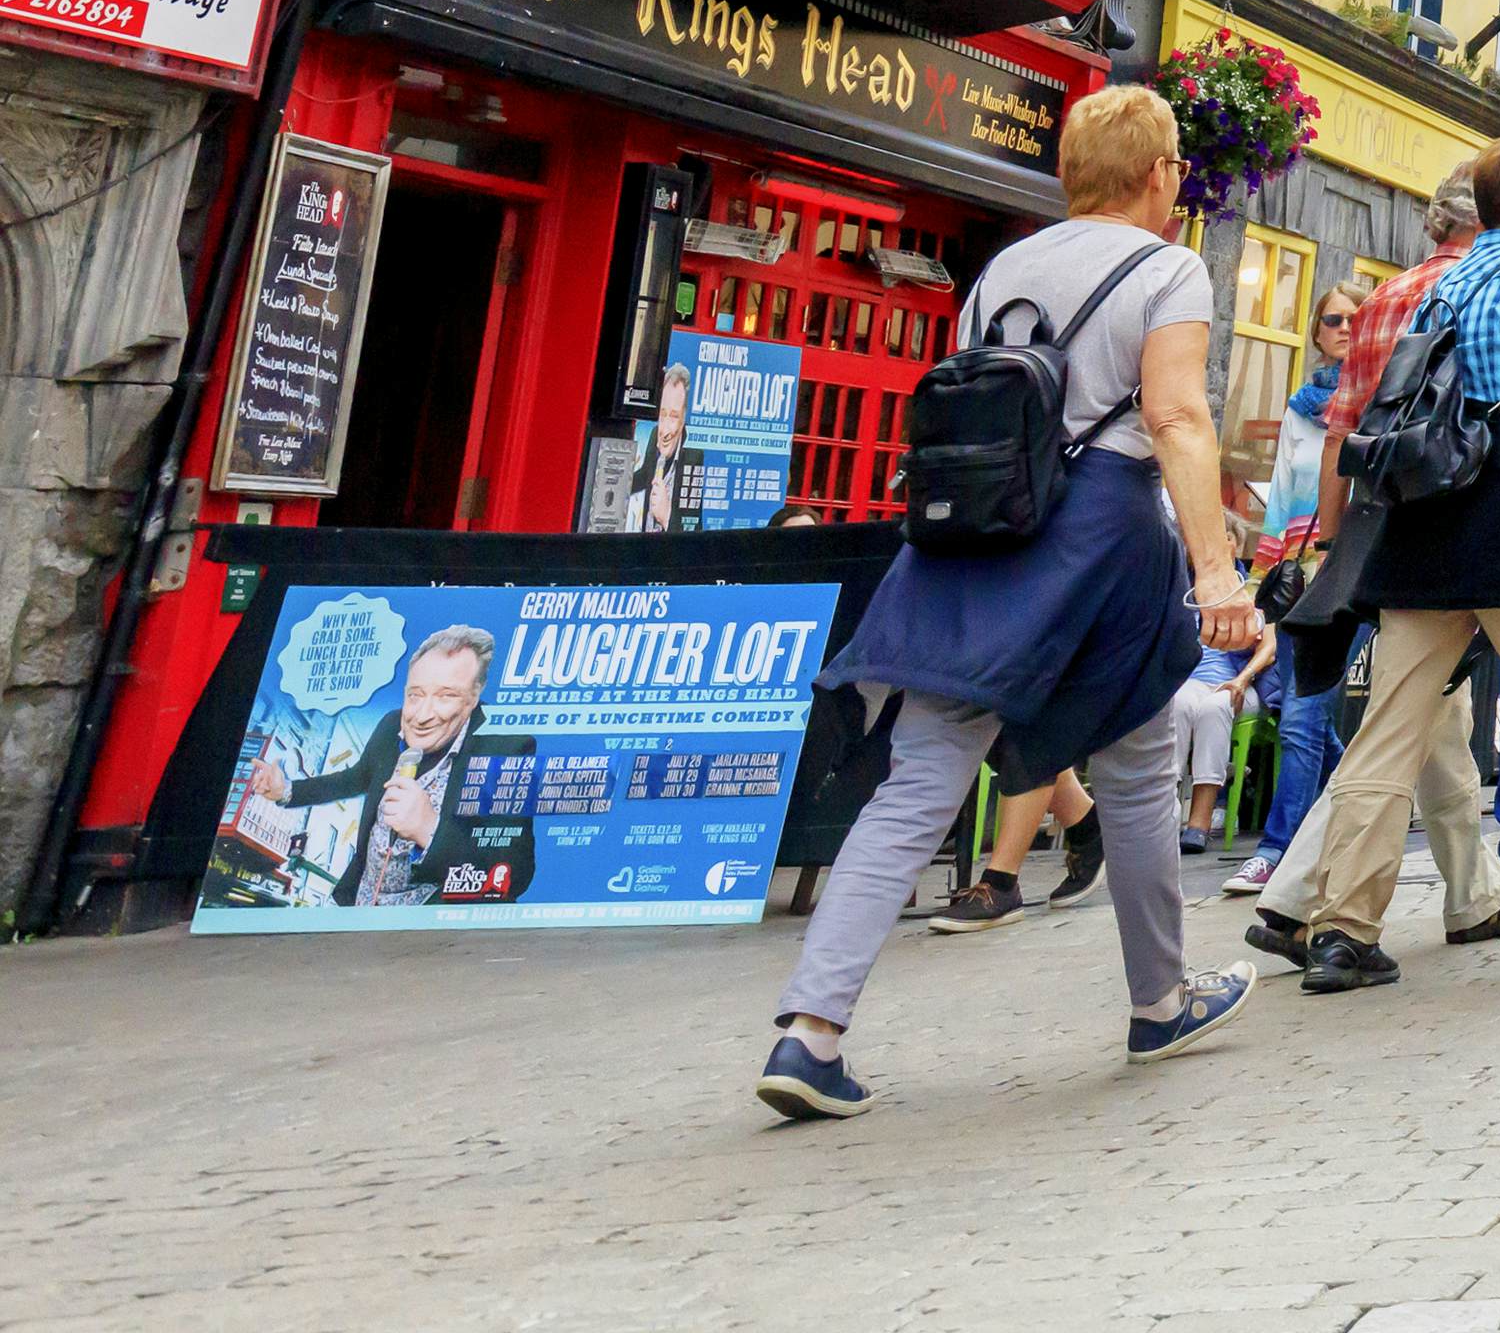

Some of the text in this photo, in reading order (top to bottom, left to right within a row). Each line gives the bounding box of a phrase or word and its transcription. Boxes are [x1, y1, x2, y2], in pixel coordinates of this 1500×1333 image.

[801, 3, 917, 113] Head
[1038, 104, 1054, 130] Bar
[971, 114, 989, 140] Bar
[296, 205, 324, 223] HEAD
[692, 366, 795, 422] LAUGHTER LOFT
[521, 592, 670, 619] GERRY MALLON'S
[322, 612, 373, 629] WHY NOT
[312, 627, 376, 645] GRAB SOME
[300, 642, 381, 661] LUNCH BEFORE
[500, 621, 817, 688] LAUGHTER LOFT
[311, 659, 363, 676] OR AFTER
[306, 675, 363, 693] THE SHOW
[496, 687, 798, 703] UPSTAIRS AT THE KINGS HEAD
[489, 710, 795, 726] HOME OF LUNCHTIME COMEDY
[604, 737, 674, 751] WEEK 2
[468, 756, 610, 770] MON JULY 24 NEIL DELAMERE
[667, 753, 779, 769] JULY JARLATH REGAN
[497, 771, 518, 784] JULY
[519, 771, 532, 784] 25
[542, 771, 573, 784] ALISON
[574, 770, 608, 783] SPITTLE
[632, 767, 778, 784] SAT JULY 29 DAVID MCSAVAGE
[461, 785, 605, 800] WED JULY JOHN COLLEARY
[628, 784, 647, 798] SUN
[660, 784, 682, 798] JULY
[682, 784, 696, 797] 30
[489, 801, 511, 815] JULY
[512, 801, 525, 814] 27
[536, 801, 554, 814] TOM
[555, 800, 589, 814] RHODES
[443, 882, 482, 893] HEAD
[636, 875, 661, 883] 2020
[634, 883, 670, 894] Galway
